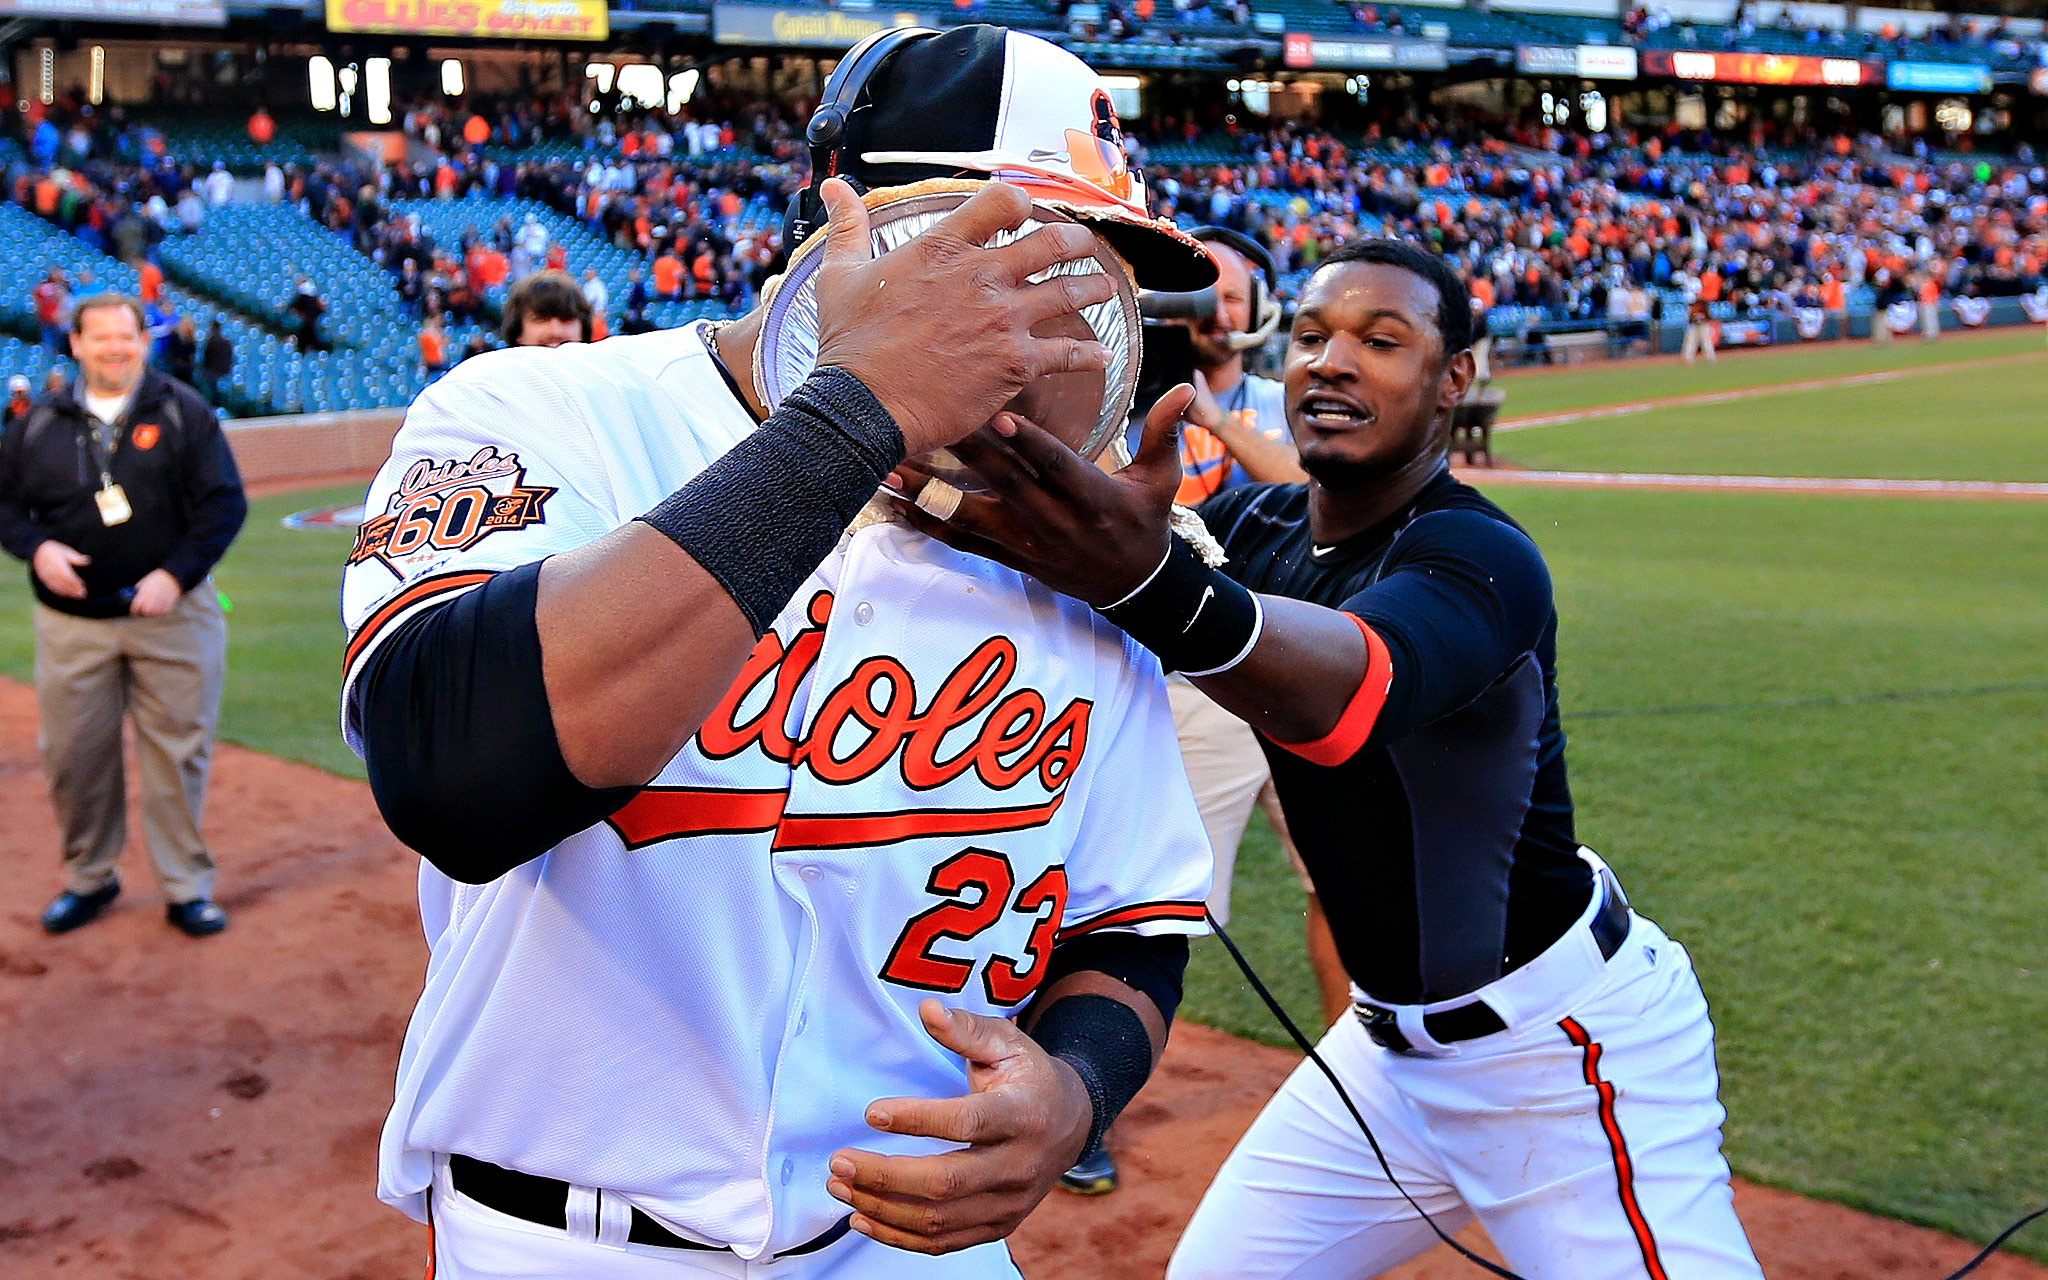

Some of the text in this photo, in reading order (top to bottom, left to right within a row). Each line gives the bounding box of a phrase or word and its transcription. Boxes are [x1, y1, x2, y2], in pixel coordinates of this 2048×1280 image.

[400, 446, 521, 497] Orioles
[385, 486, 492, 558] 60
[485, 515, 518, 525] 2014
[878, 846, 1069, 1008] 23
